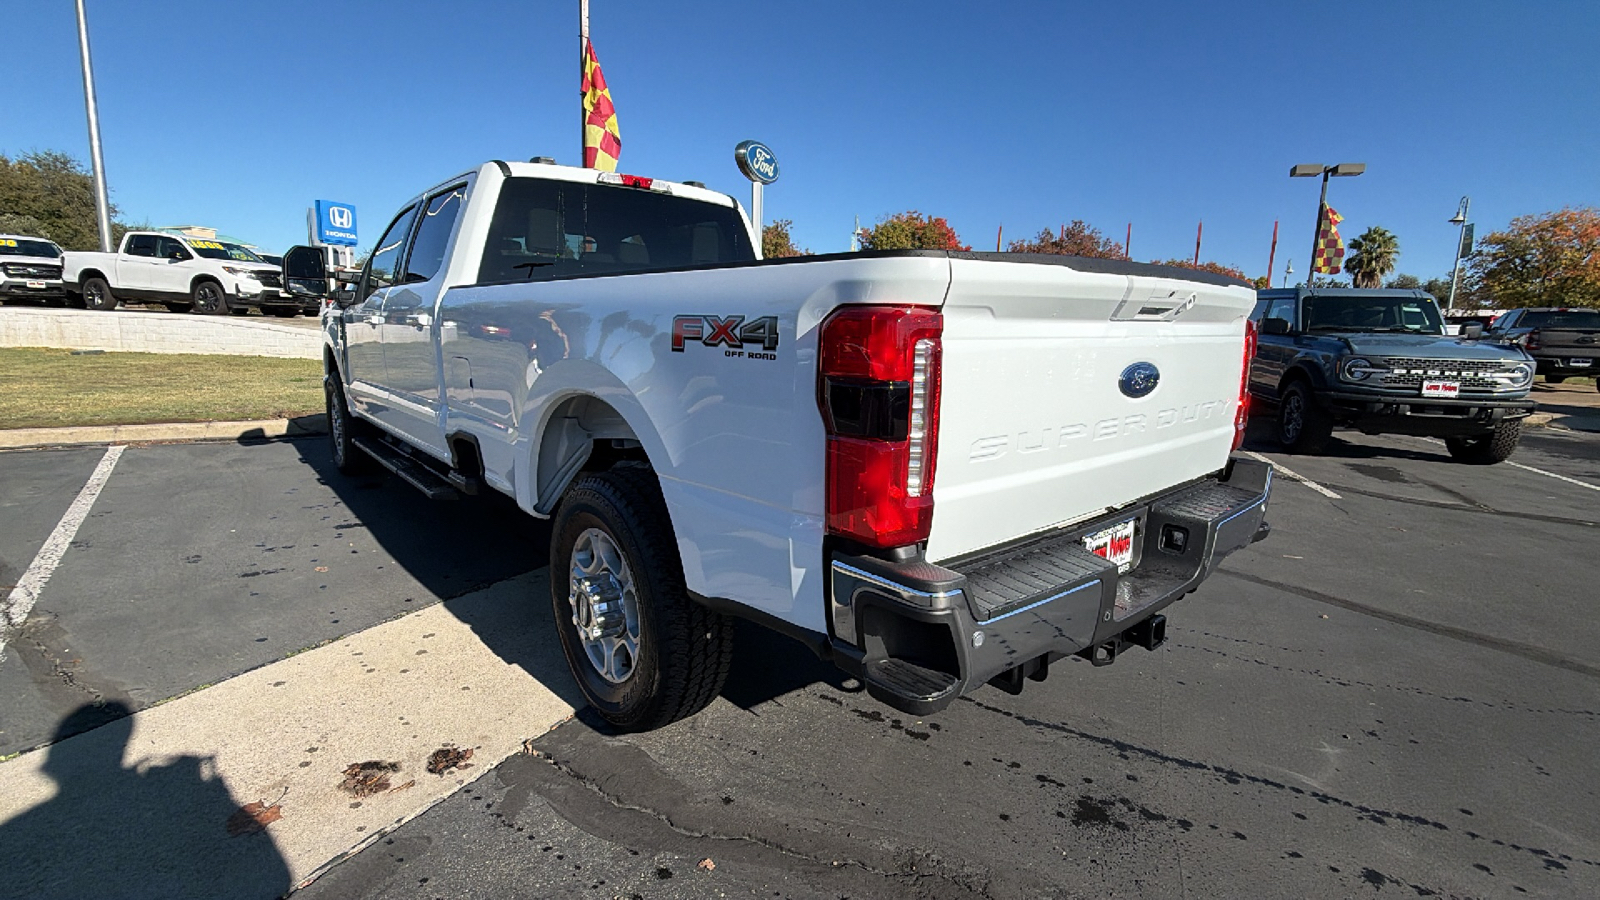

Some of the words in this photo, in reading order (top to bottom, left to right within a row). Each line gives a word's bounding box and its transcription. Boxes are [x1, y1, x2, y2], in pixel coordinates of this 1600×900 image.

[753, 148, 775, 177] Ford
[325, 230, 357, 239] HONDA
[671, 314, 779, 353] FX4
[724, 350, 745, 358] OFF
[747, 351, 777, 360] ROAD
[1393, 368, 1491, 377] BRONCO
[968, 413, 1147, 464] SUPER
[1156, 399, 1232, 430] DUTY
